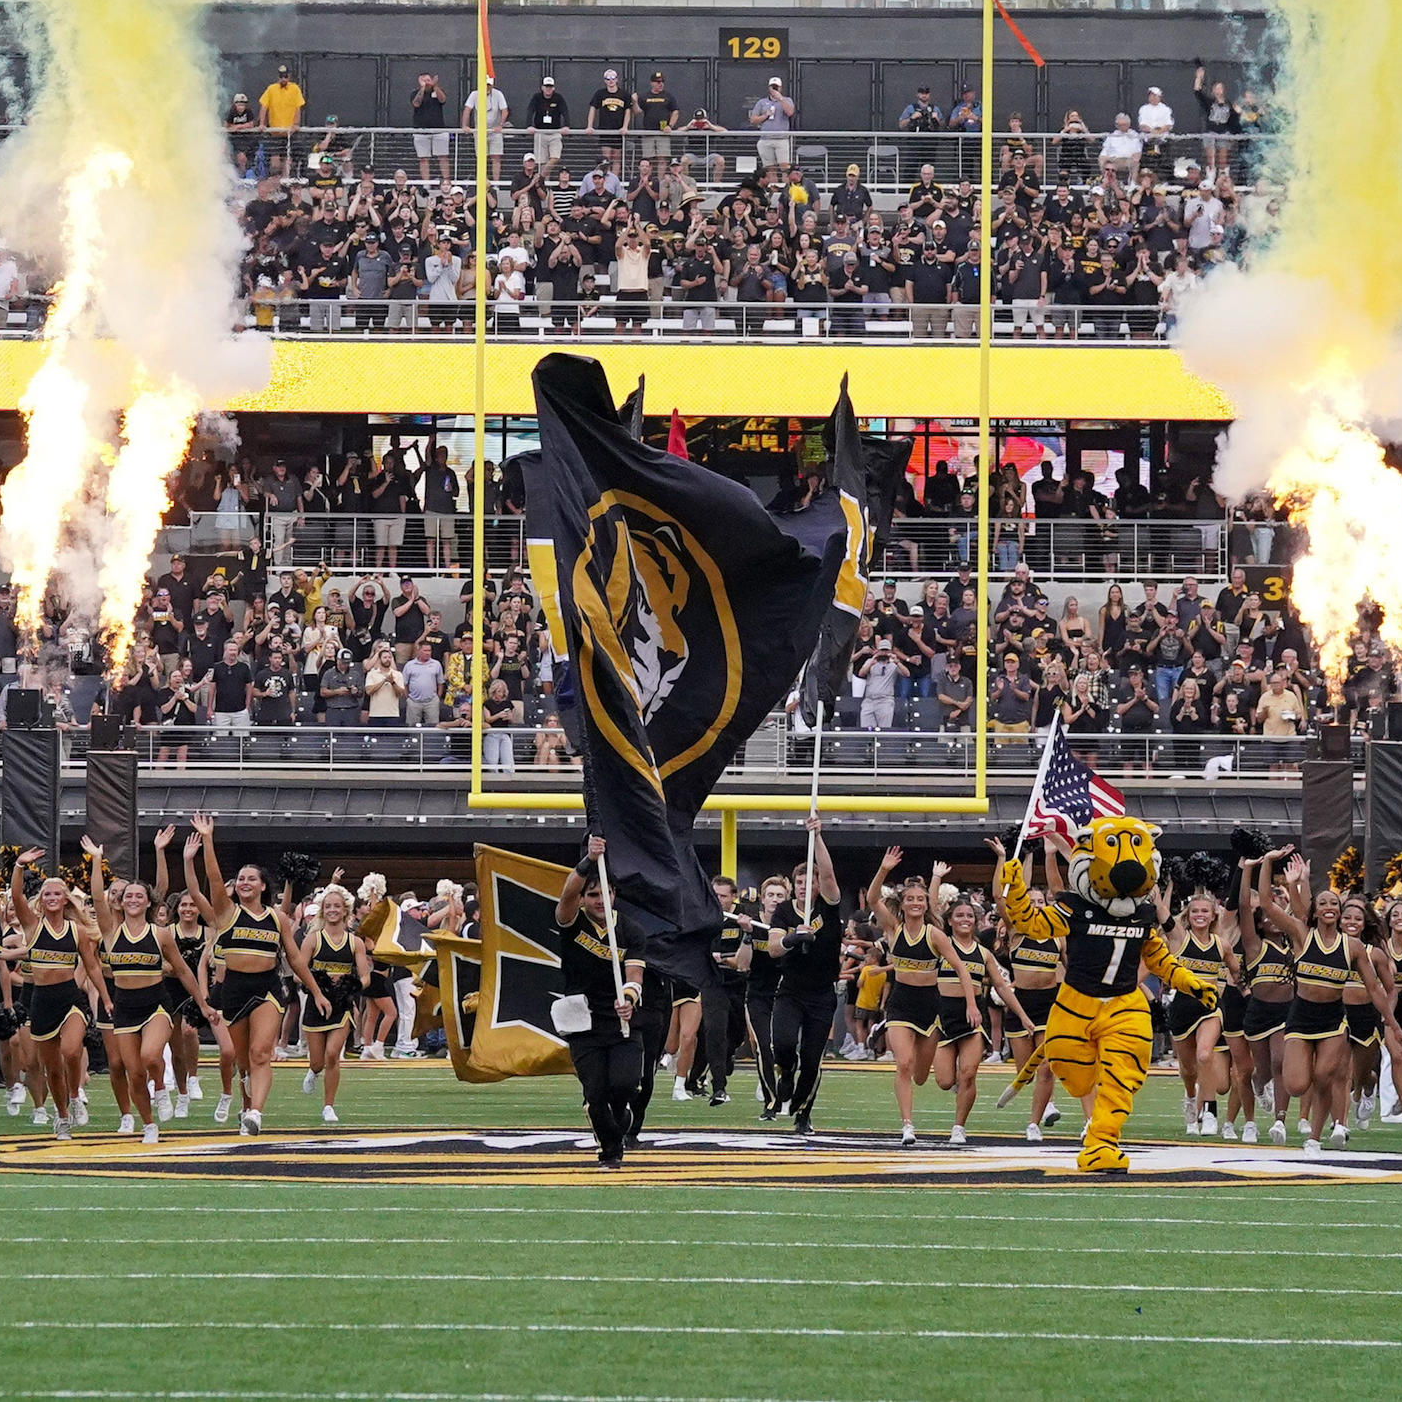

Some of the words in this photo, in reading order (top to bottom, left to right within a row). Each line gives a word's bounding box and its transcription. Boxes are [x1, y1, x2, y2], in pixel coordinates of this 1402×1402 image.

[727, 36, 781, 59] 129
[1263, 576, 1284, 601] 3
[1087, 923, 1144, 939] MIZZOU
[1101, 938, 1128, 986] 1
[1297, 961, 1348, 980] MIZZOU
